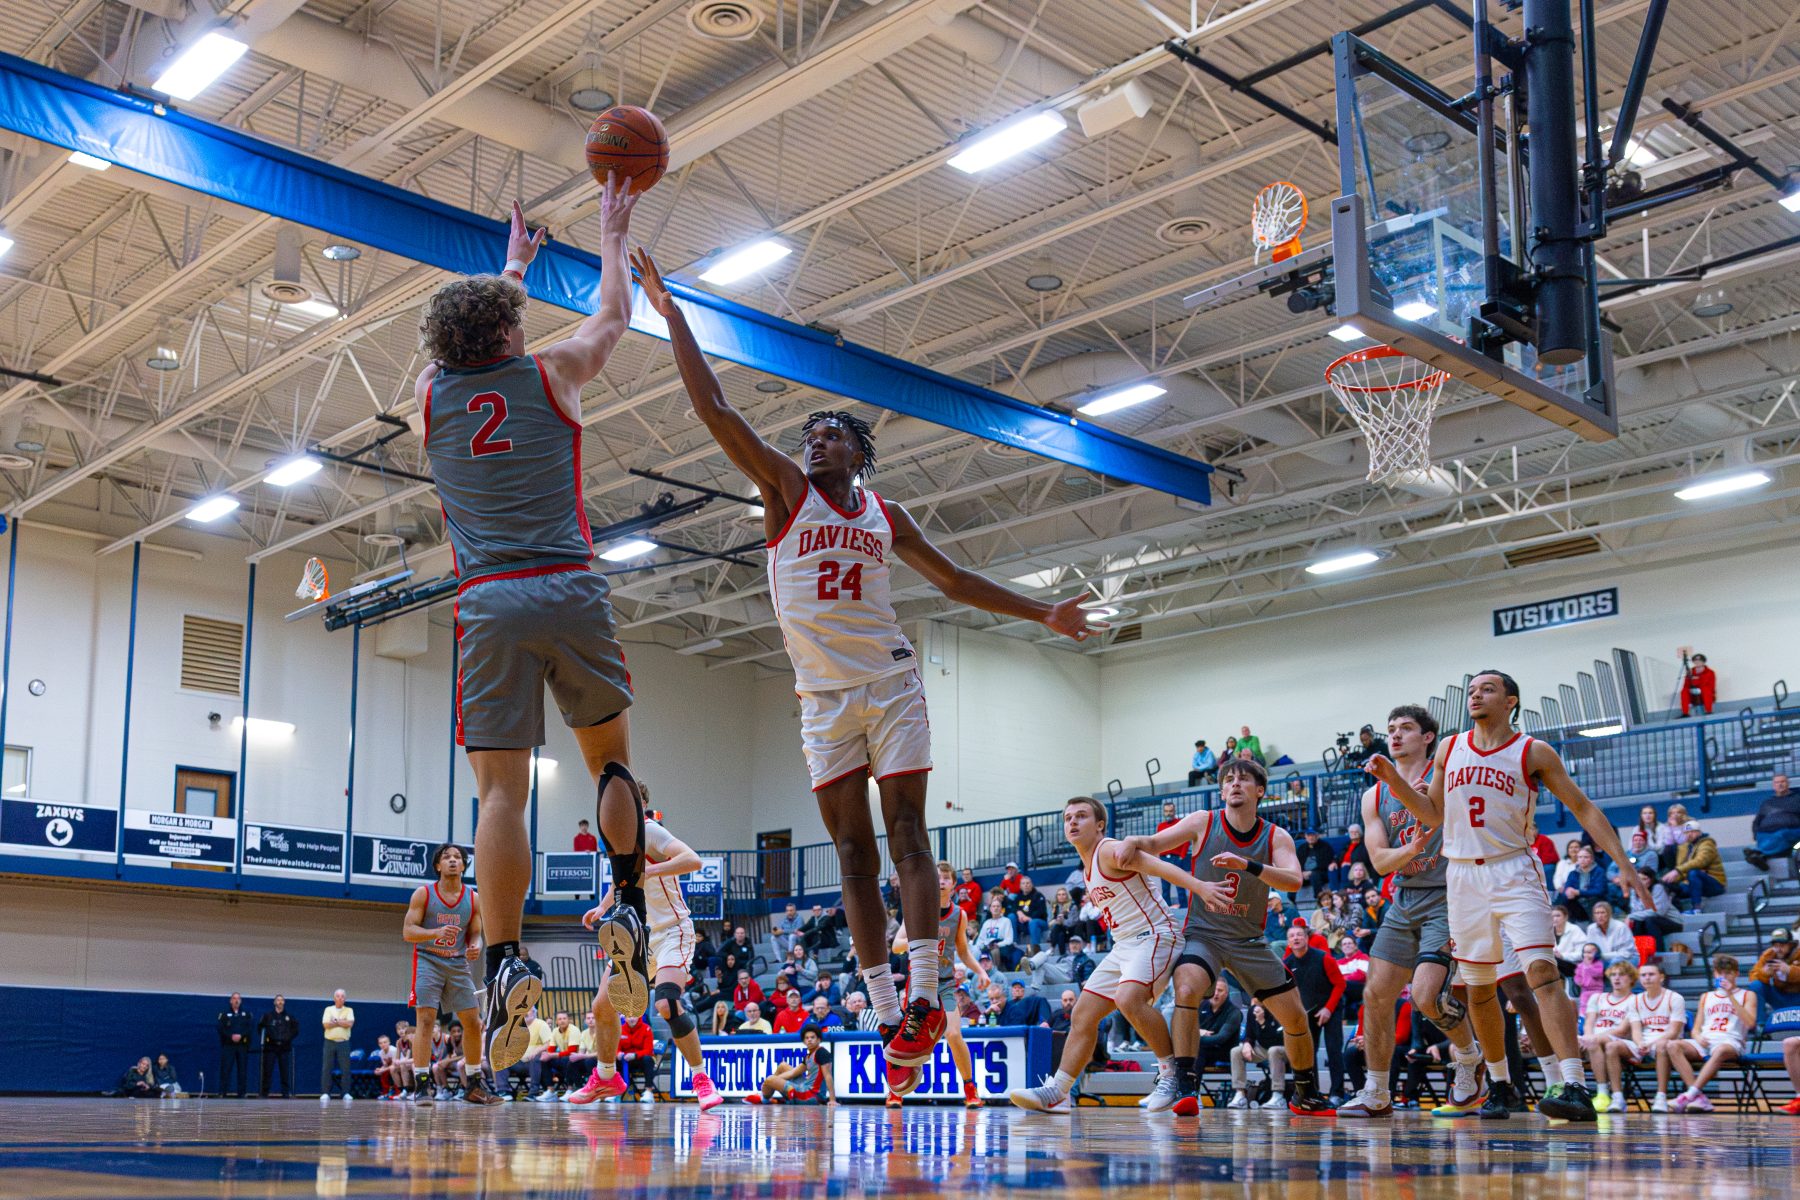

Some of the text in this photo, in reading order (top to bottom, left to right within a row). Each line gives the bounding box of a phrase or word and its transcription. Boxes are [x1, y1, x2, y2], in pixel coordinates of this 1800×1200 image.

[466, 390, 513, 458] 2
[797, 524, 884, 565] DAVIESS
[817, 560, 864, 601] 24
[1498, 591, 1613, 632] VISITORS
[1447, 766, 1516, 797] DAVIESS
[36, 804, 85, 822] ZAXBYS
[151, 815, 178, 827] MORGAN
[178, 817, 184, 828] &
[184, 818, 211, 830] MORGAN
[1468, 796, 1486, 828] 2
[296, 841, 306, 850] We
[306, 843, 320, 852] Help
[246, 855, 341, 871] TheFamilyWealthGroup.com
[550, 869, 589, 877] PETERSON
[687, 883, 716, 893] GUEST
